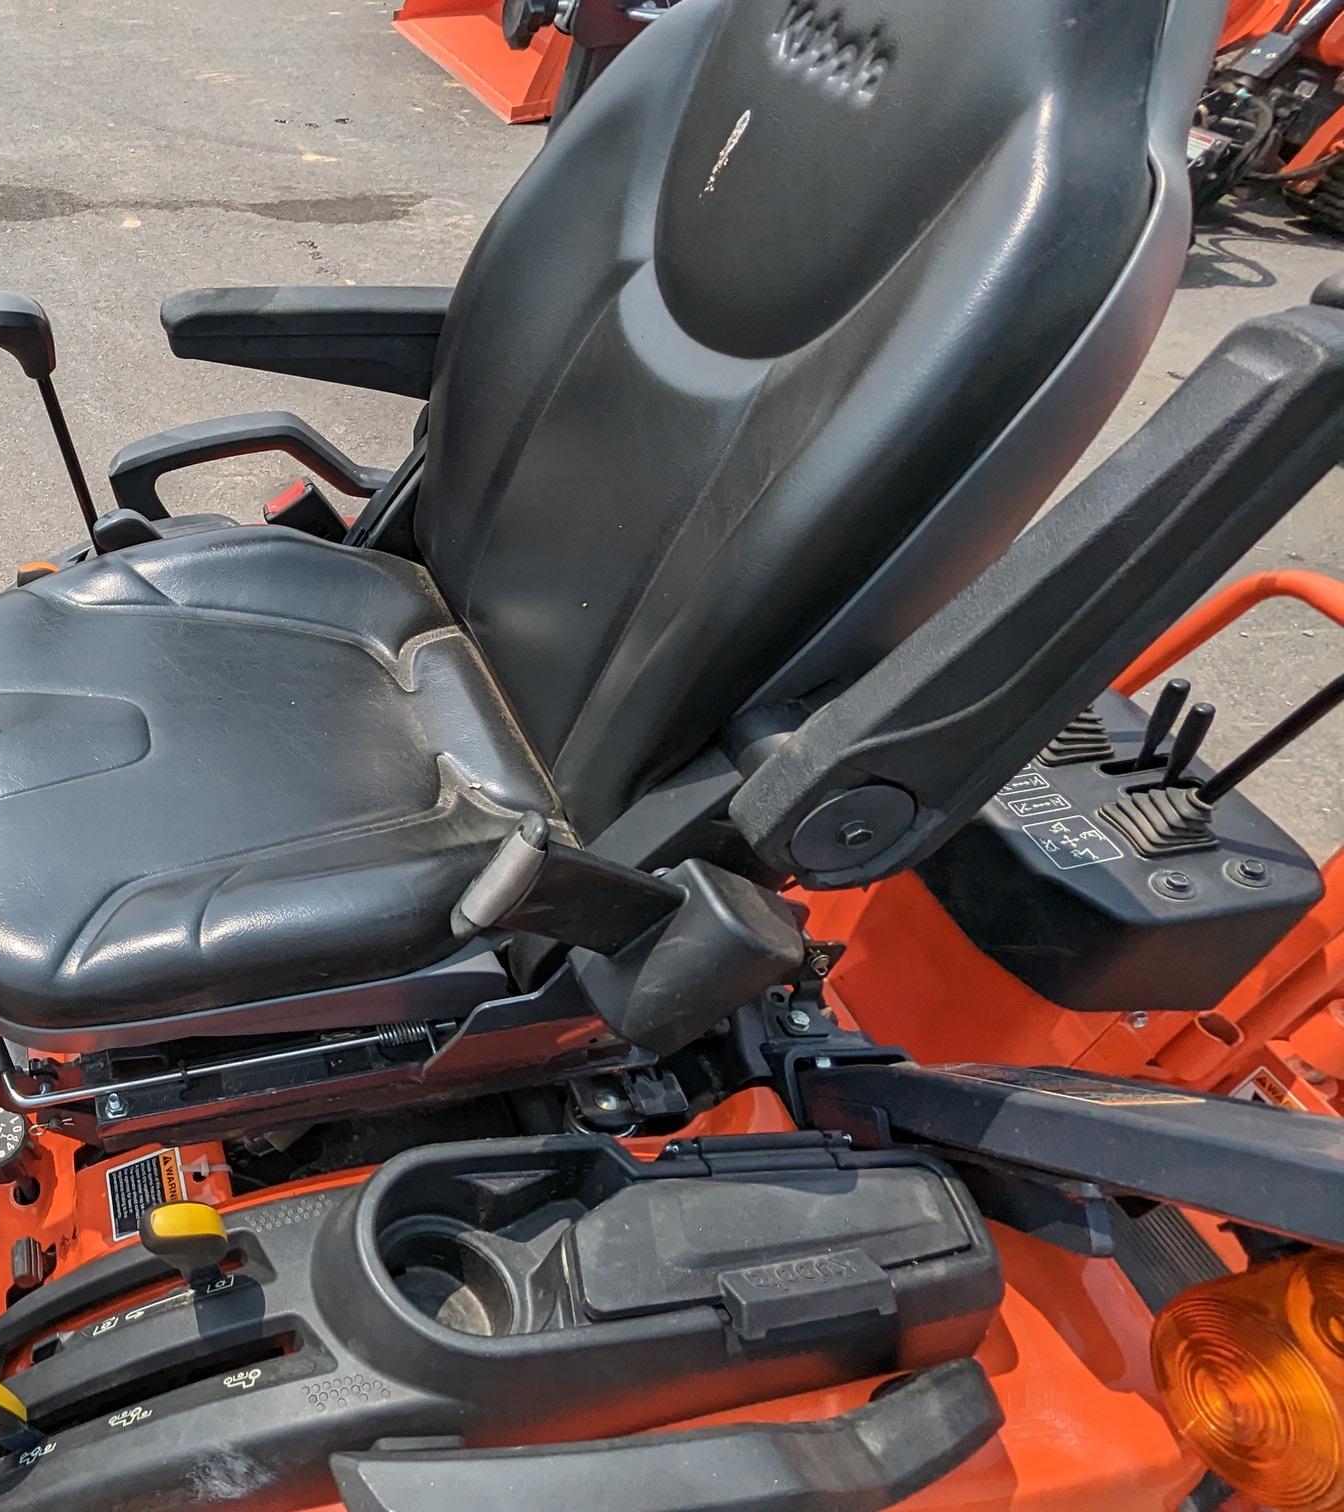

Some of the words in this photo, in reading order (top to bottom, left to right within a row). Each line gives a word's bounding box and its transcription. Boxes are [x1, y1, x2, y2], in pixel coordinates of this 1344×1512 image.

[767, 2, 895, 102] Kubota
[0, 1133, 19, 1143] TOP
[6, 1142, 15, 1151] 4
[166, 1166, 178, 1201] WARN
[743, 1257, 859, 1291] Kubota
